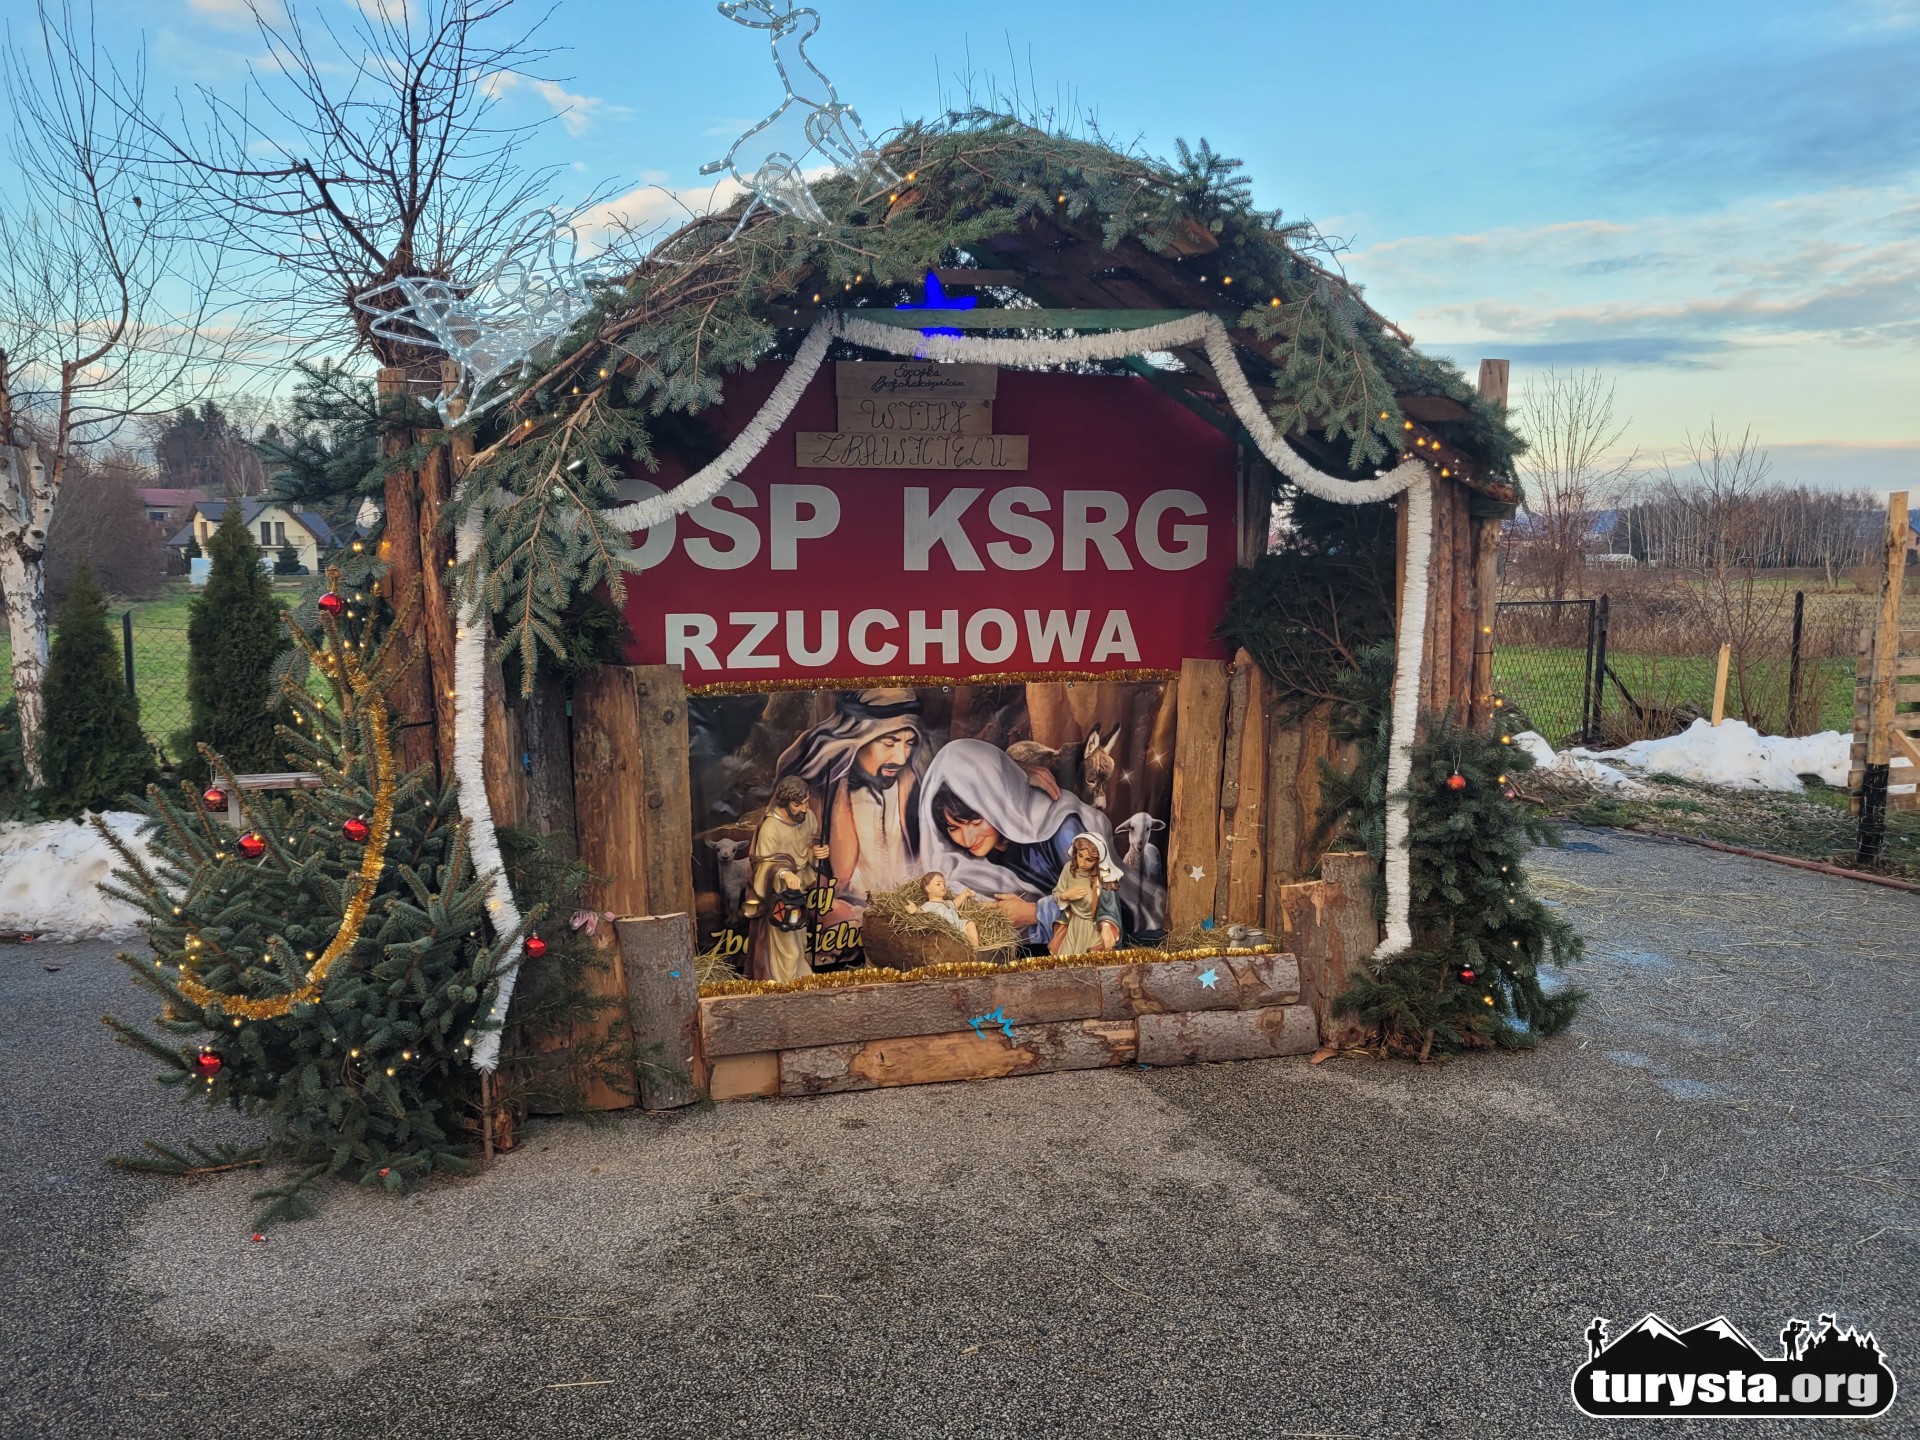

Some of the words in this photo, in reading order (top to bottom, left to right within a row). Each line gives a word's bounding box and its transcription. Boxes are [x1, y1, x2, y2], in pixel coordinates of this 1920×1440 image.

[894, 363, 941, 379] Szopka
[860, 400, 971, 433] WITAJ
[812, 434, 1008, 468] ZBAWICIELU
[903, 486, 1209, 571] KSRG
[664, 608, 1142, 671] RZUCHOWA
